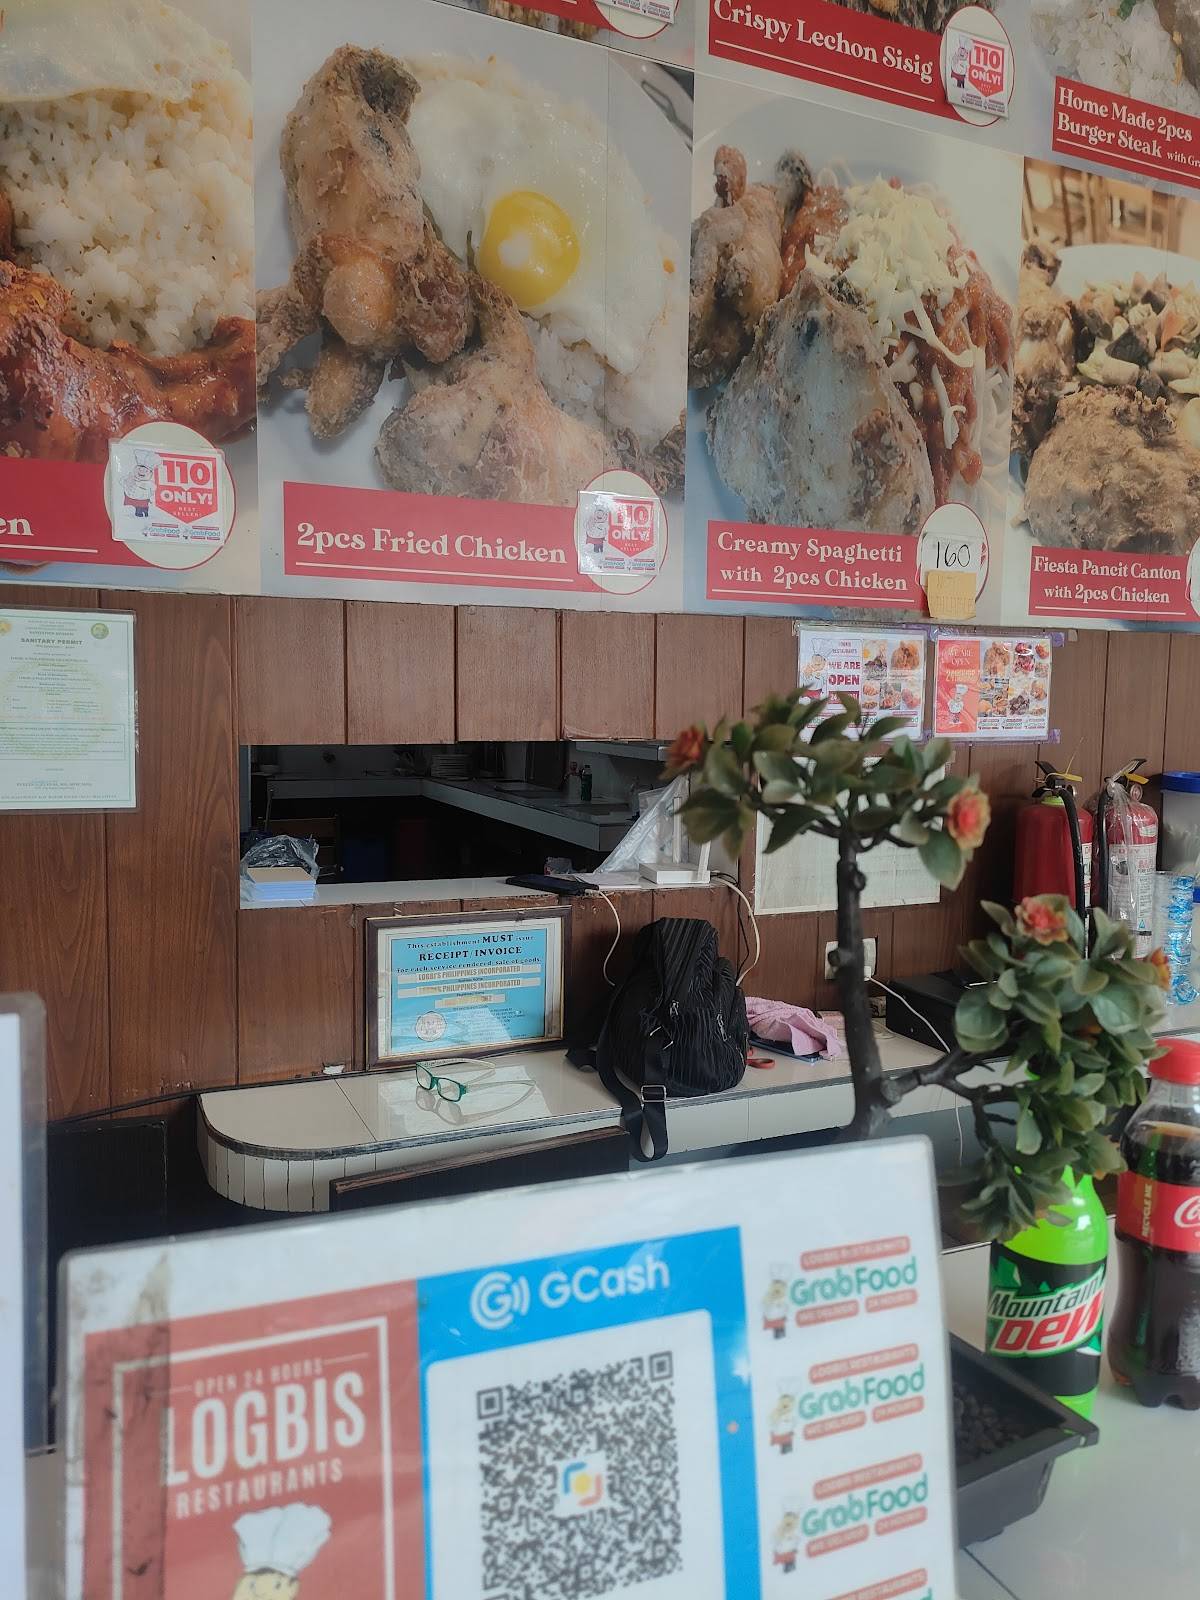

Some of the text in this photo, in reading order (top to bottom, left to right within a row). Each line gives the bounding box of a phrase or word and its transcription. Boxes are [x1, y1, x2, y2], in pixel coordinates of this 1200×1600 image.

[714, 0, 933, 84] Crispy Lechon Sisig
[974, 46, 1001, 69] 110
[971, 69, 1001, 85] ONLY!
[1058, 86, 1193, 142] Home Made 2pcs
[1057, 111, 1115, 145] Burger
[1117, 129, 1162, 158] Steak
[1166, 151, 1187, 164] with
[162, 459, 211, 486] 110
[160, 489, 213, 506] ONLY!
[297, 522, 366, 554] 2pcs
[372, 528, 449, 556] Fried
[454, 534, 568, 564] Chicken
[717, 531, 902, 564] Creamy Spaghetti
[936, 541, 971, 569] 160
[720, 565, 909, 591] with 2pcs Chicken
[1033, 556, 1181, 580] Fiesta Pancit Canton
[1044, 583, 1170, 604] with 2pcs Chicken
[828, 661, 861, 669] WE ARE
[828, 674, 860, 685] OPEN
[426, 938, 481, 948] establishment
[482, 934, 514, 944] MUST
[410, 965, 428, 973] each
[430, 963, 457, 971] service
[442, 968, 478, 979] PHILIPPINES
[478, 965, 521, 975] INCORPORATED
[442, 981, 478, 992] PHILIPPINES
[478, 979, 521, 990] INCORPORATED
[538, 1254, 670, 1309] GCash
[790, 1256, 918, 1306] GrabFood
[991, 1274, 1100, 1317] Mountain
[195, 1358, 323, 1397] OPEN 24 HOURS
[798, 1362, 925, 1420] GrabFood
[167, 1371, 366, 1486] LOGBIS
[175, 1458, 343, 1519] RESTAURANTS
[802, 1473, 928, 1536] GrabFood
